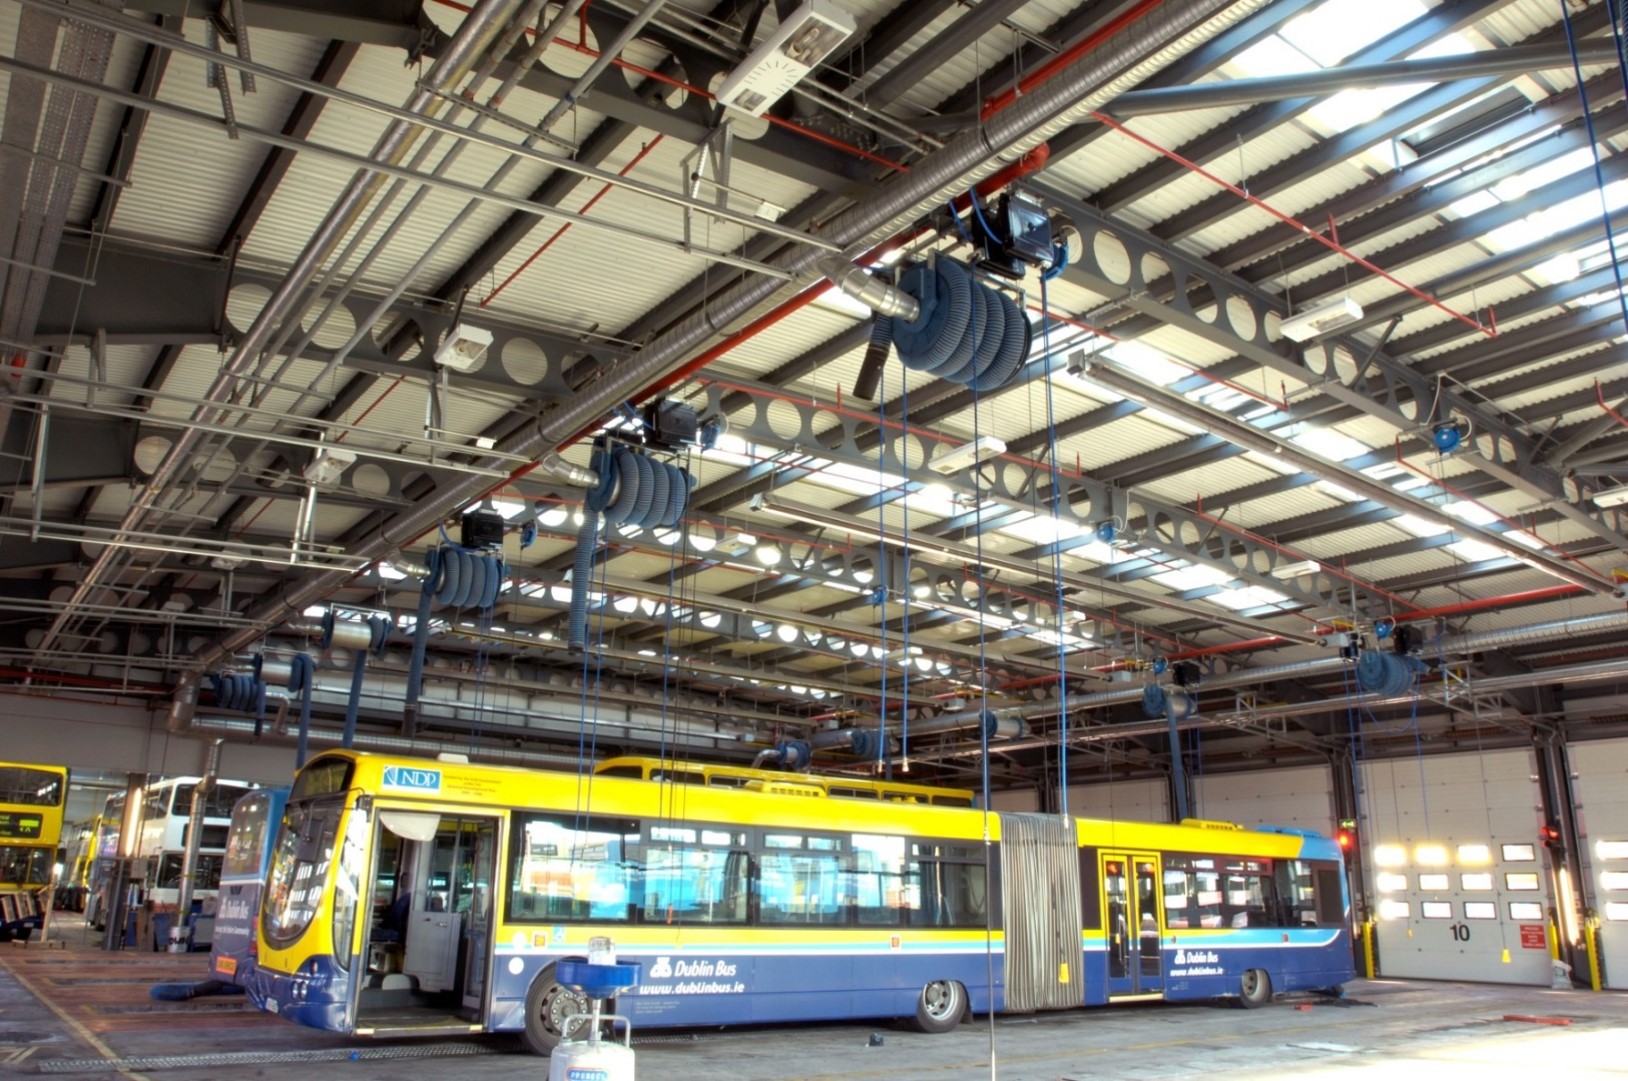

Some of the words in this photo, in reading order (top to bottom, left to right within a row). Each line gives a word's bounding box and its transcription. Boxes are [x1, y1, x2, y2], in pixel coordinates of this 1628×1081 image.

[402, 770, 436, 787] NDP
[1449, 924, 1471, 942] 10
[1187, 951, 1207, 964] Dublin
[1207, 951, 1219, 963] Bus
[674, 960, 714, 976] Dublin
[715, 960, 737, 976] Bus
[1169, 966, 1224, 977] www.dublinbus.ie
[639, 981, 745, 995] www.dublinbus.ie
